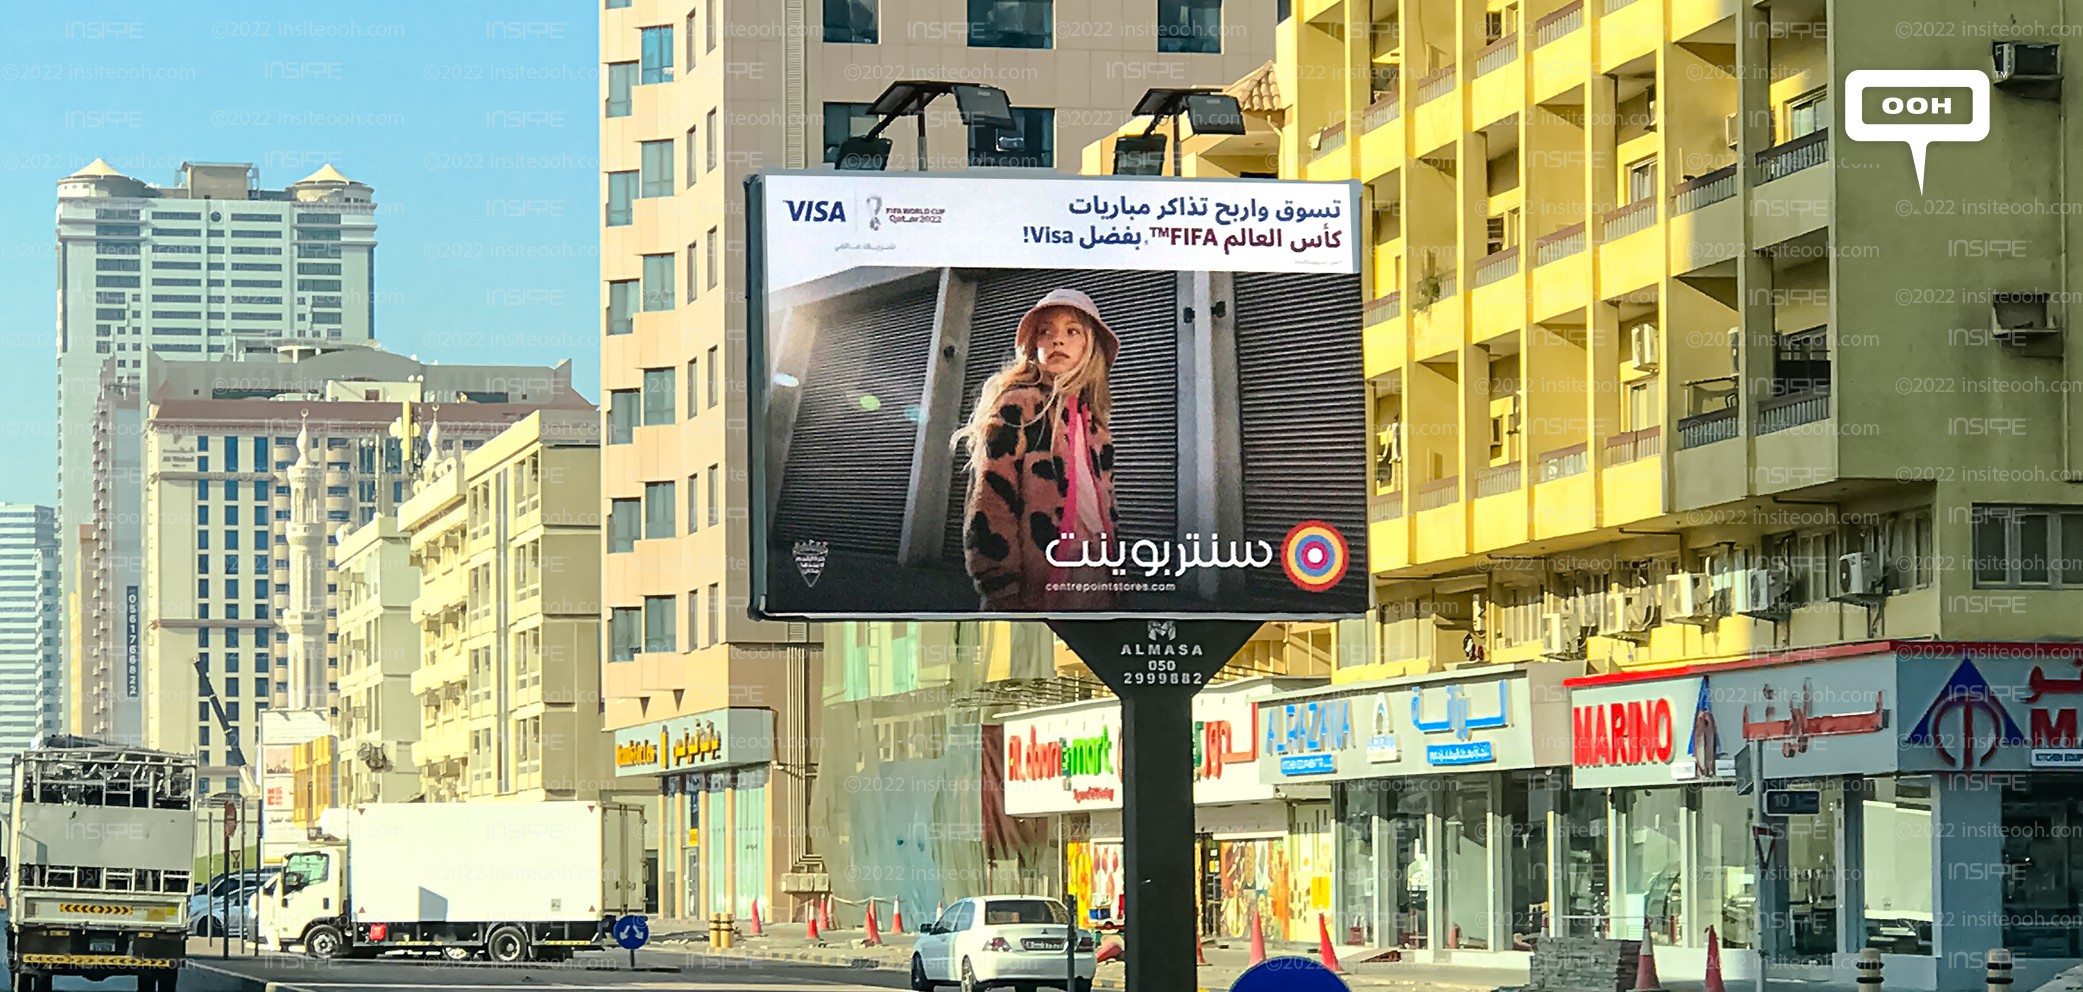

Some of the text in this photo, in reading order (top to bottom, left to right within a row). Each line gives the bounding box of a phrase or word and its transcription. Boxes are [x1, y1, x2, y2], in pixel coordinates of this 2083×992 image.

[783, 200, 847, 222] VISA
[1069, 196, 1341, 225] تسوق واربح تذاكر مباريات
[1079, 226, 1142, 250] بفضل
[1223, 228, 1282, 255] العالم
[1290, 223, 1342, 252] كأس
[1045, 532, 1273, 577] سنتربوينت
[1045, 583, 1176, 593] centrepointstores.com
[1120, 644, 1203, 655] ALMASA
[1148, 660, 1176, 671] 050
[1123, 672, 1203, 685] 2999882
[1573, 697, 1674, 767] MARINO
[1772, 793, 1790, 807] 10
